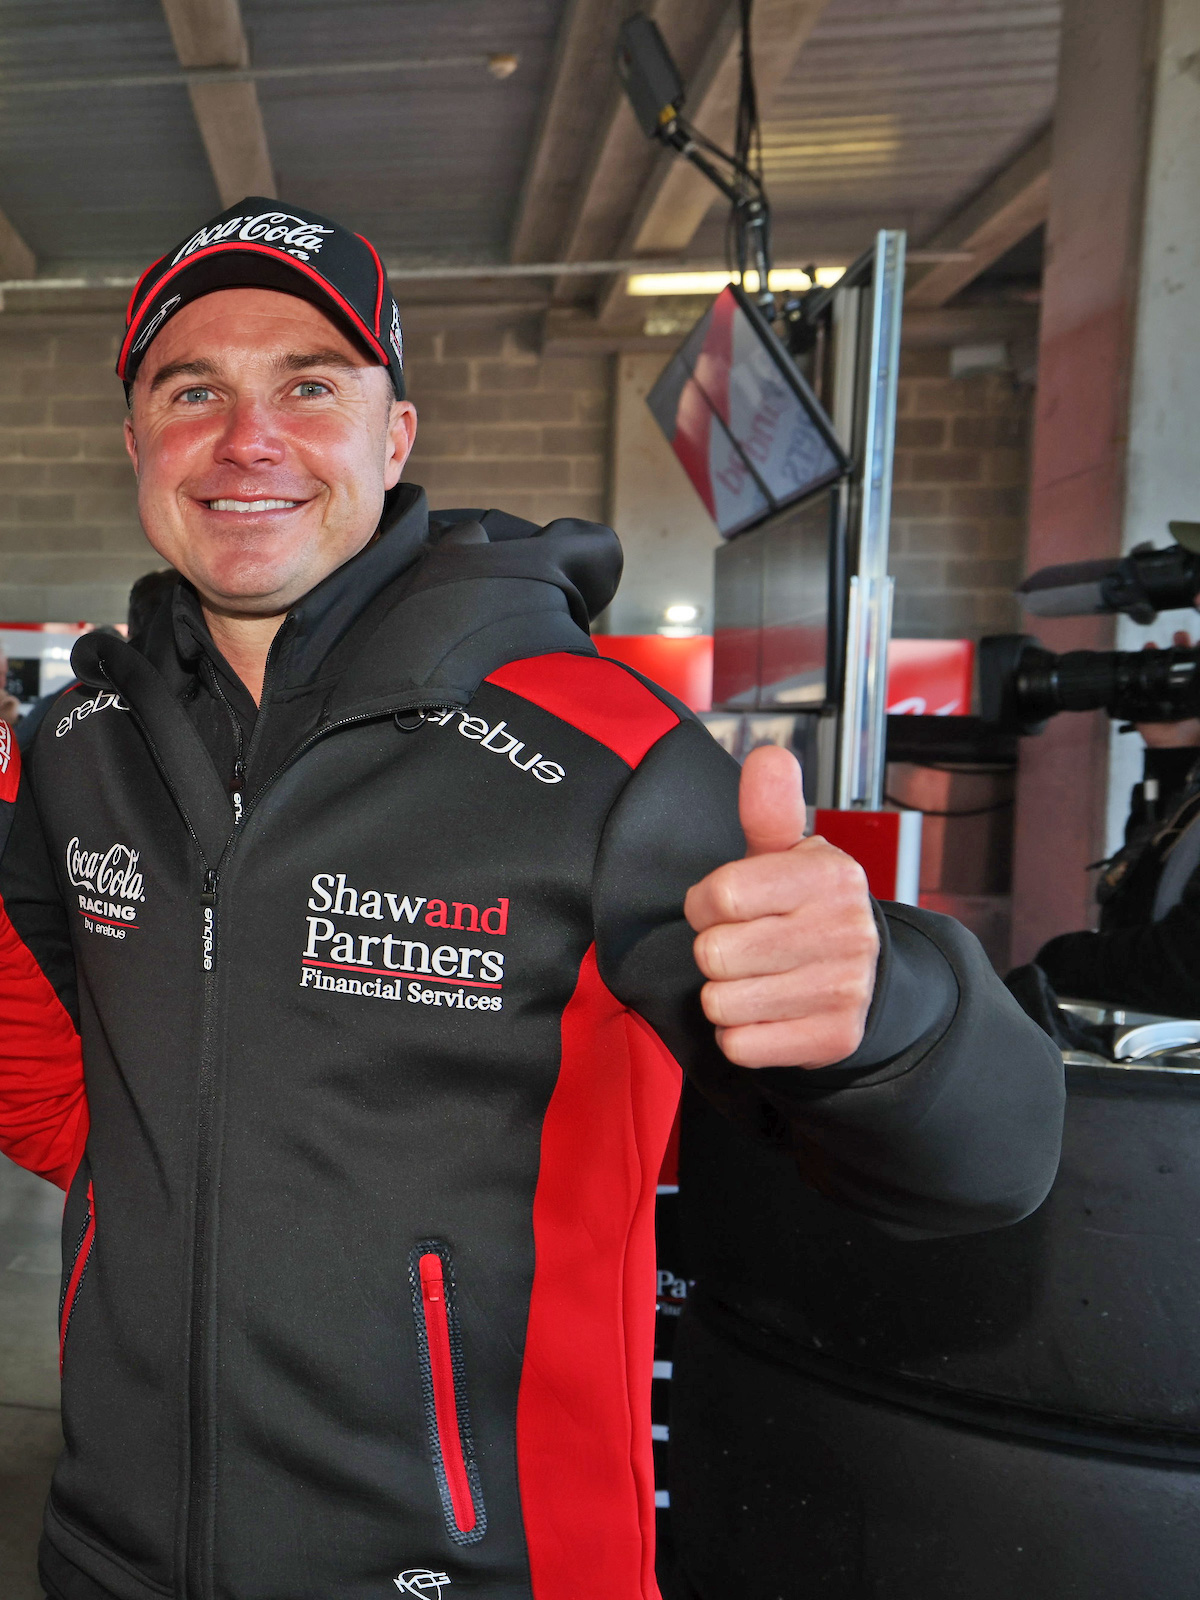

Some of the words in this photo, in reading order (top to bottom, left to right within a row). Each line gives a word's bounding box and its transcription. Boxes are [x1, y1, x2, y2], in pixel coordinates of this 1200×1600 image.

[66, 836, 146, 902] Coca-Cola
[78, 894, 137, 921] RACING
[302, 915, 505, 982] Partners
[299, 966, 402, 1001] Financial
[406, 981, 503, 1011] Services
